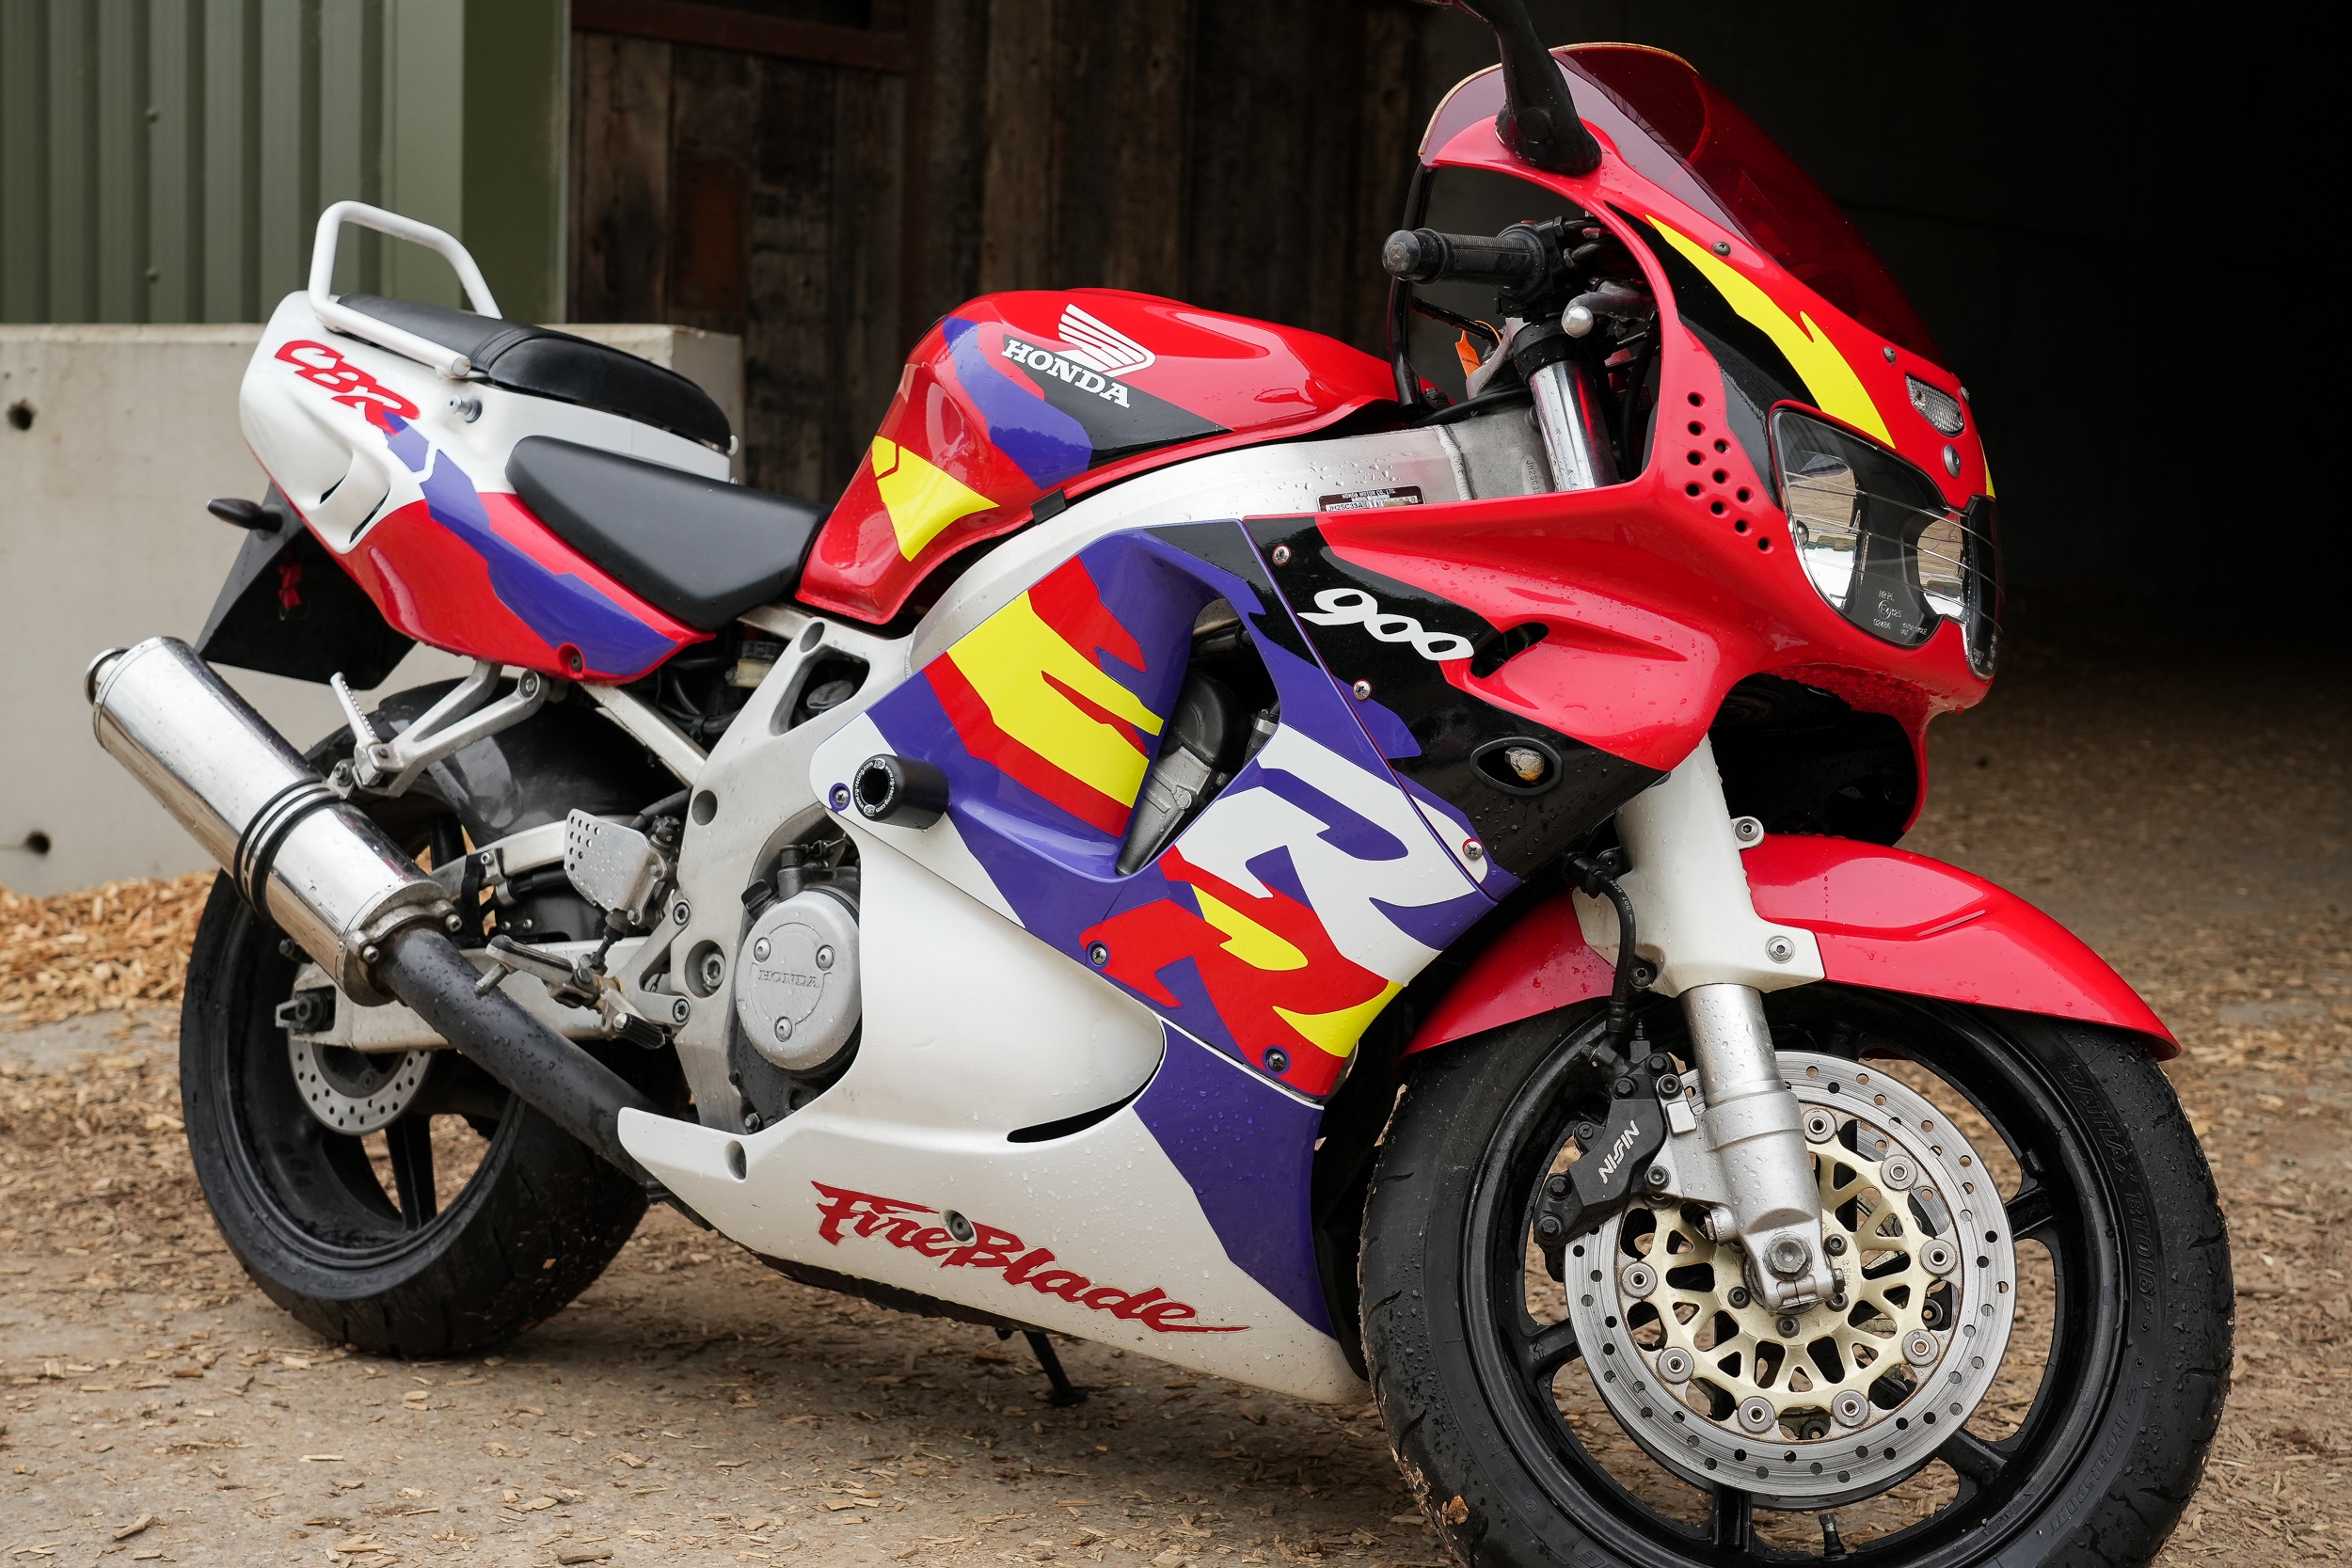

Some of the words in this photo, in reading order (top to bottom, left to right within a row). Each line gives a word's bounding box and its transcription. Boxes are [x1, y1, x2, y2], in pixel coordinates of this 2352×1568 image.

[274, 340, 421, 436] CBR
[1000, 339, 1131, 409] HONDA
[1296, 587, 1475, 661] 900
[757, 969, 821, 989] HONDA
[1597, 1119, 1641, 1185] NISSIN
[2058, 1063, 2138, 1183] BATTLAX
[810, 1180, 1252, 1333] FireBlade
[2048, 1409, 2130, 1537] HYPERSPORT
